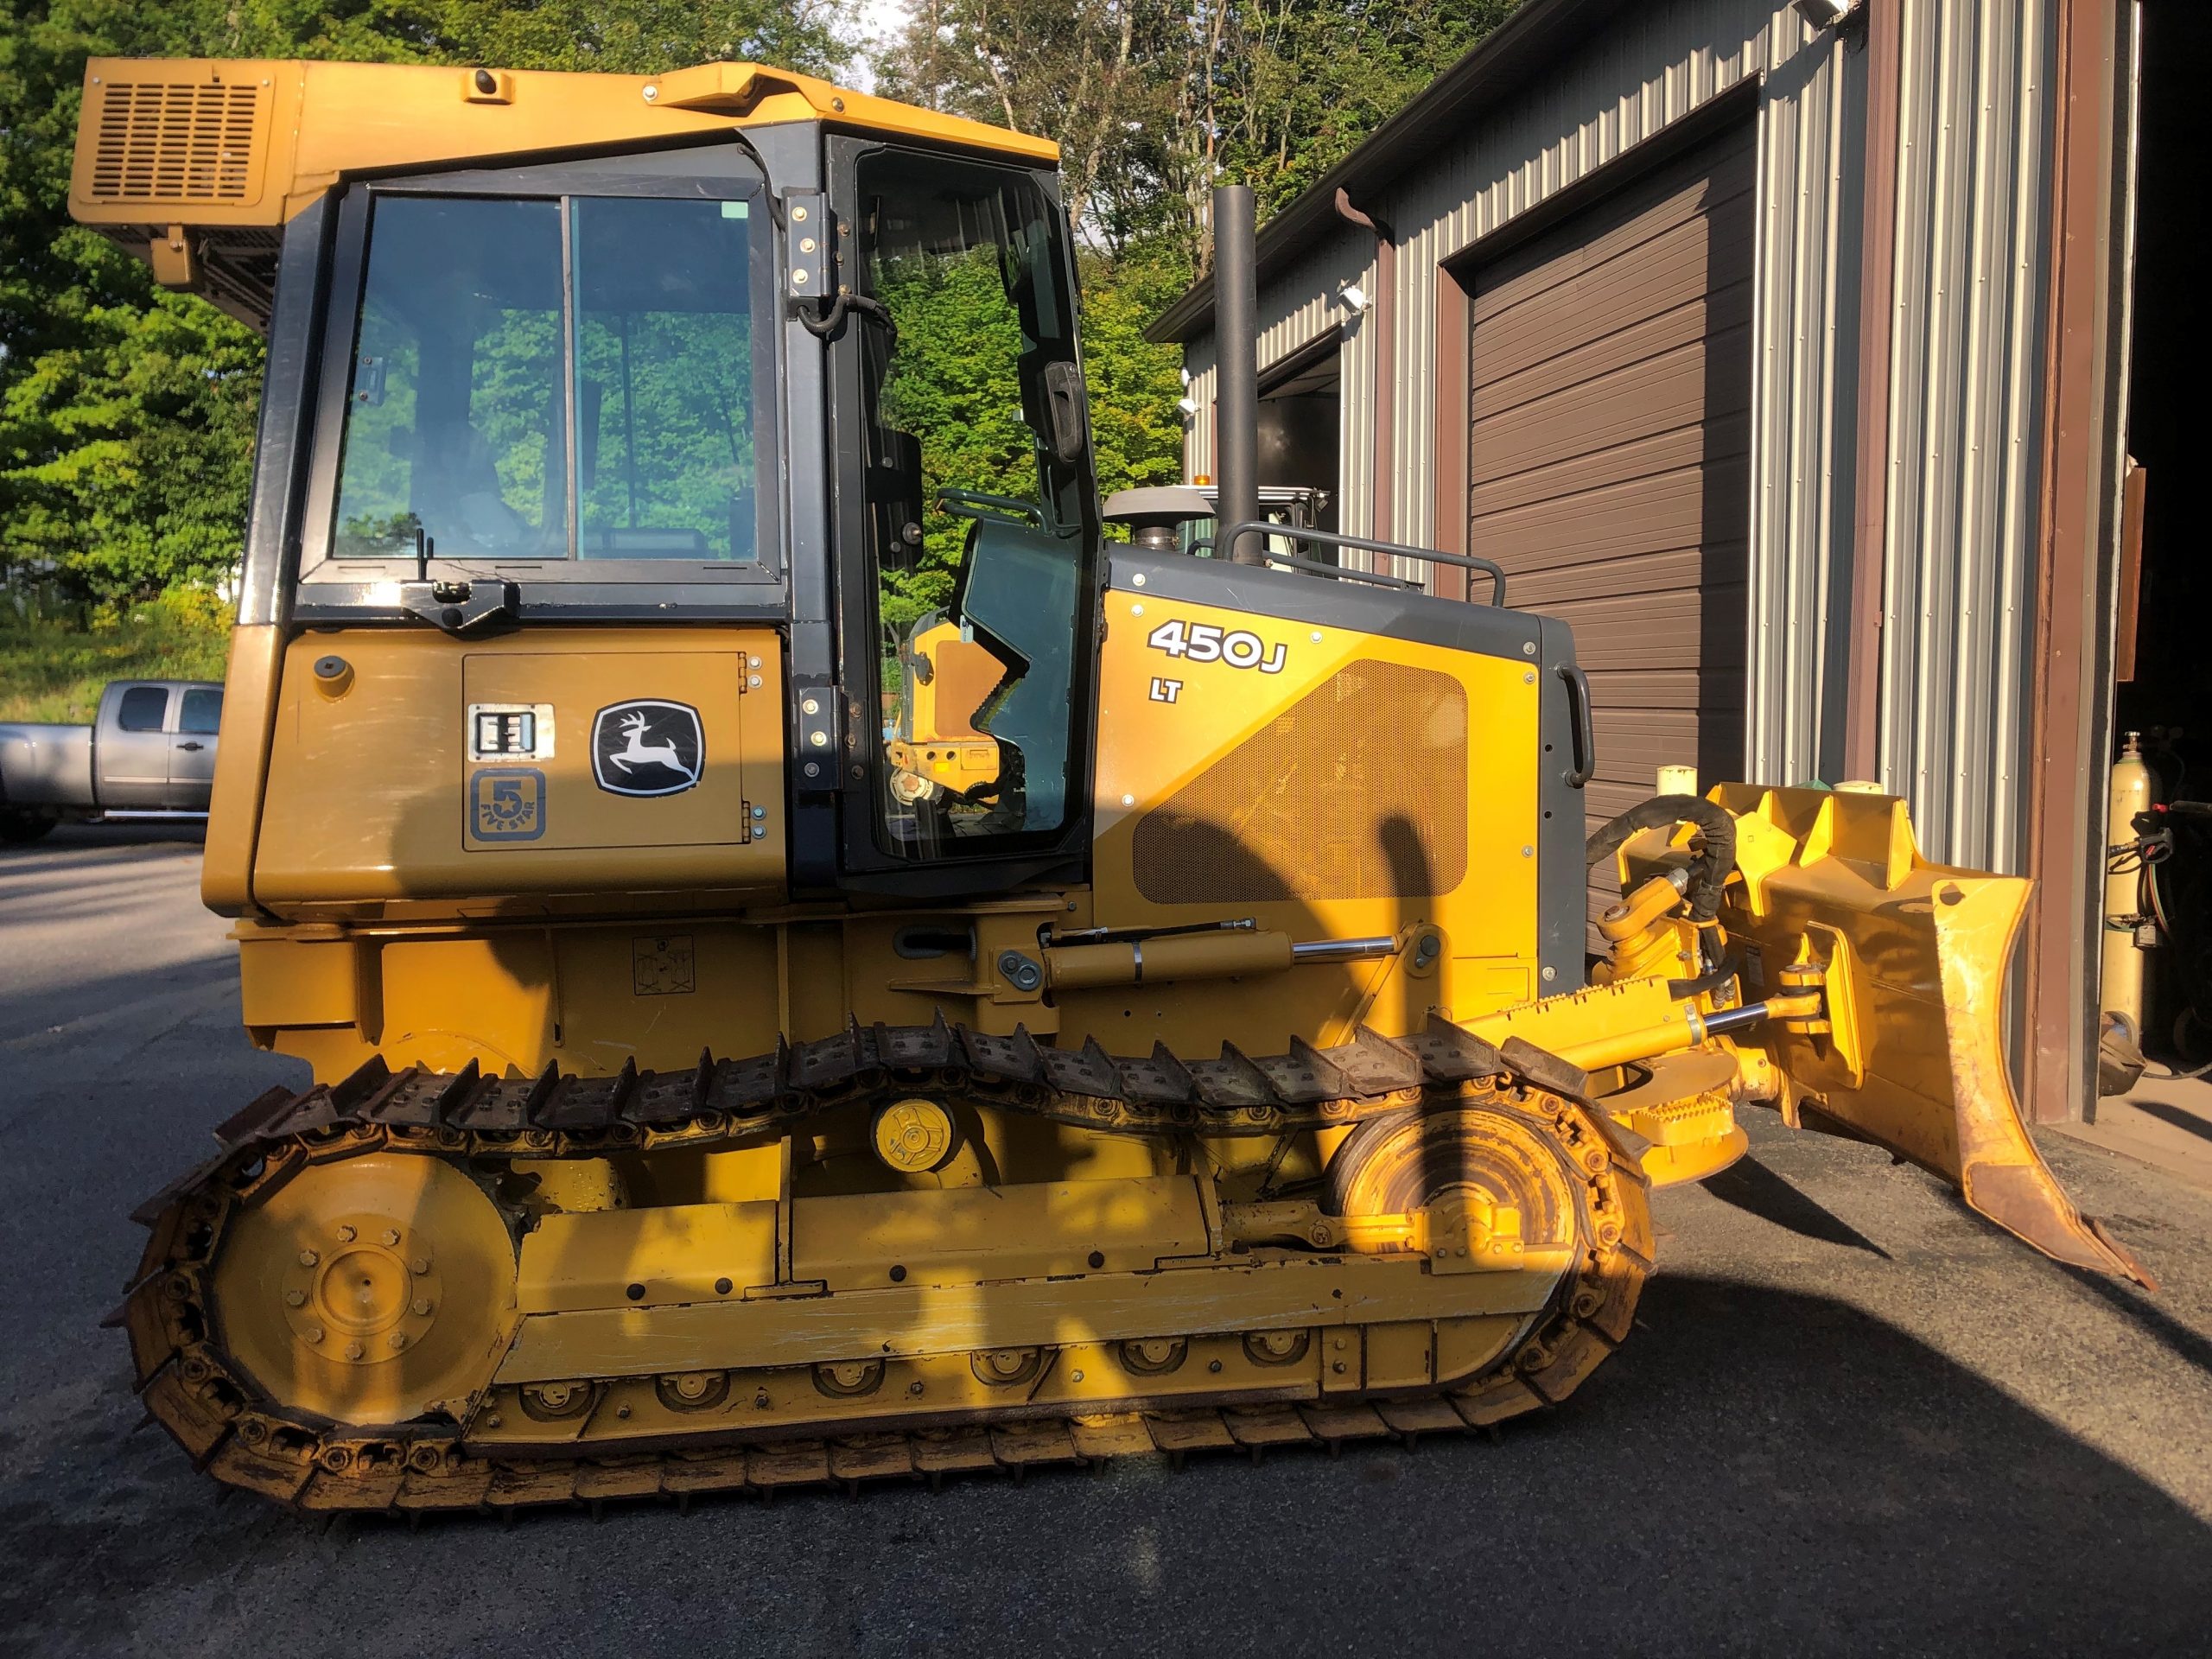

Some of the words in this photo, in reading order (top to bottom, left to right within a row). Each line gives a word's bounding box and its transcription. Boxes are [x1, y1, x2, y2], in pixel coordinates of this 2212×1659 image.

[1147, 619, 1287, 674] 450J
[1148, 677, 1184, 704] LT
[493, 780, 522, 818] 5
[480, 804, 504, 830] FIVE
[509, 802, 535, 830] STAR
